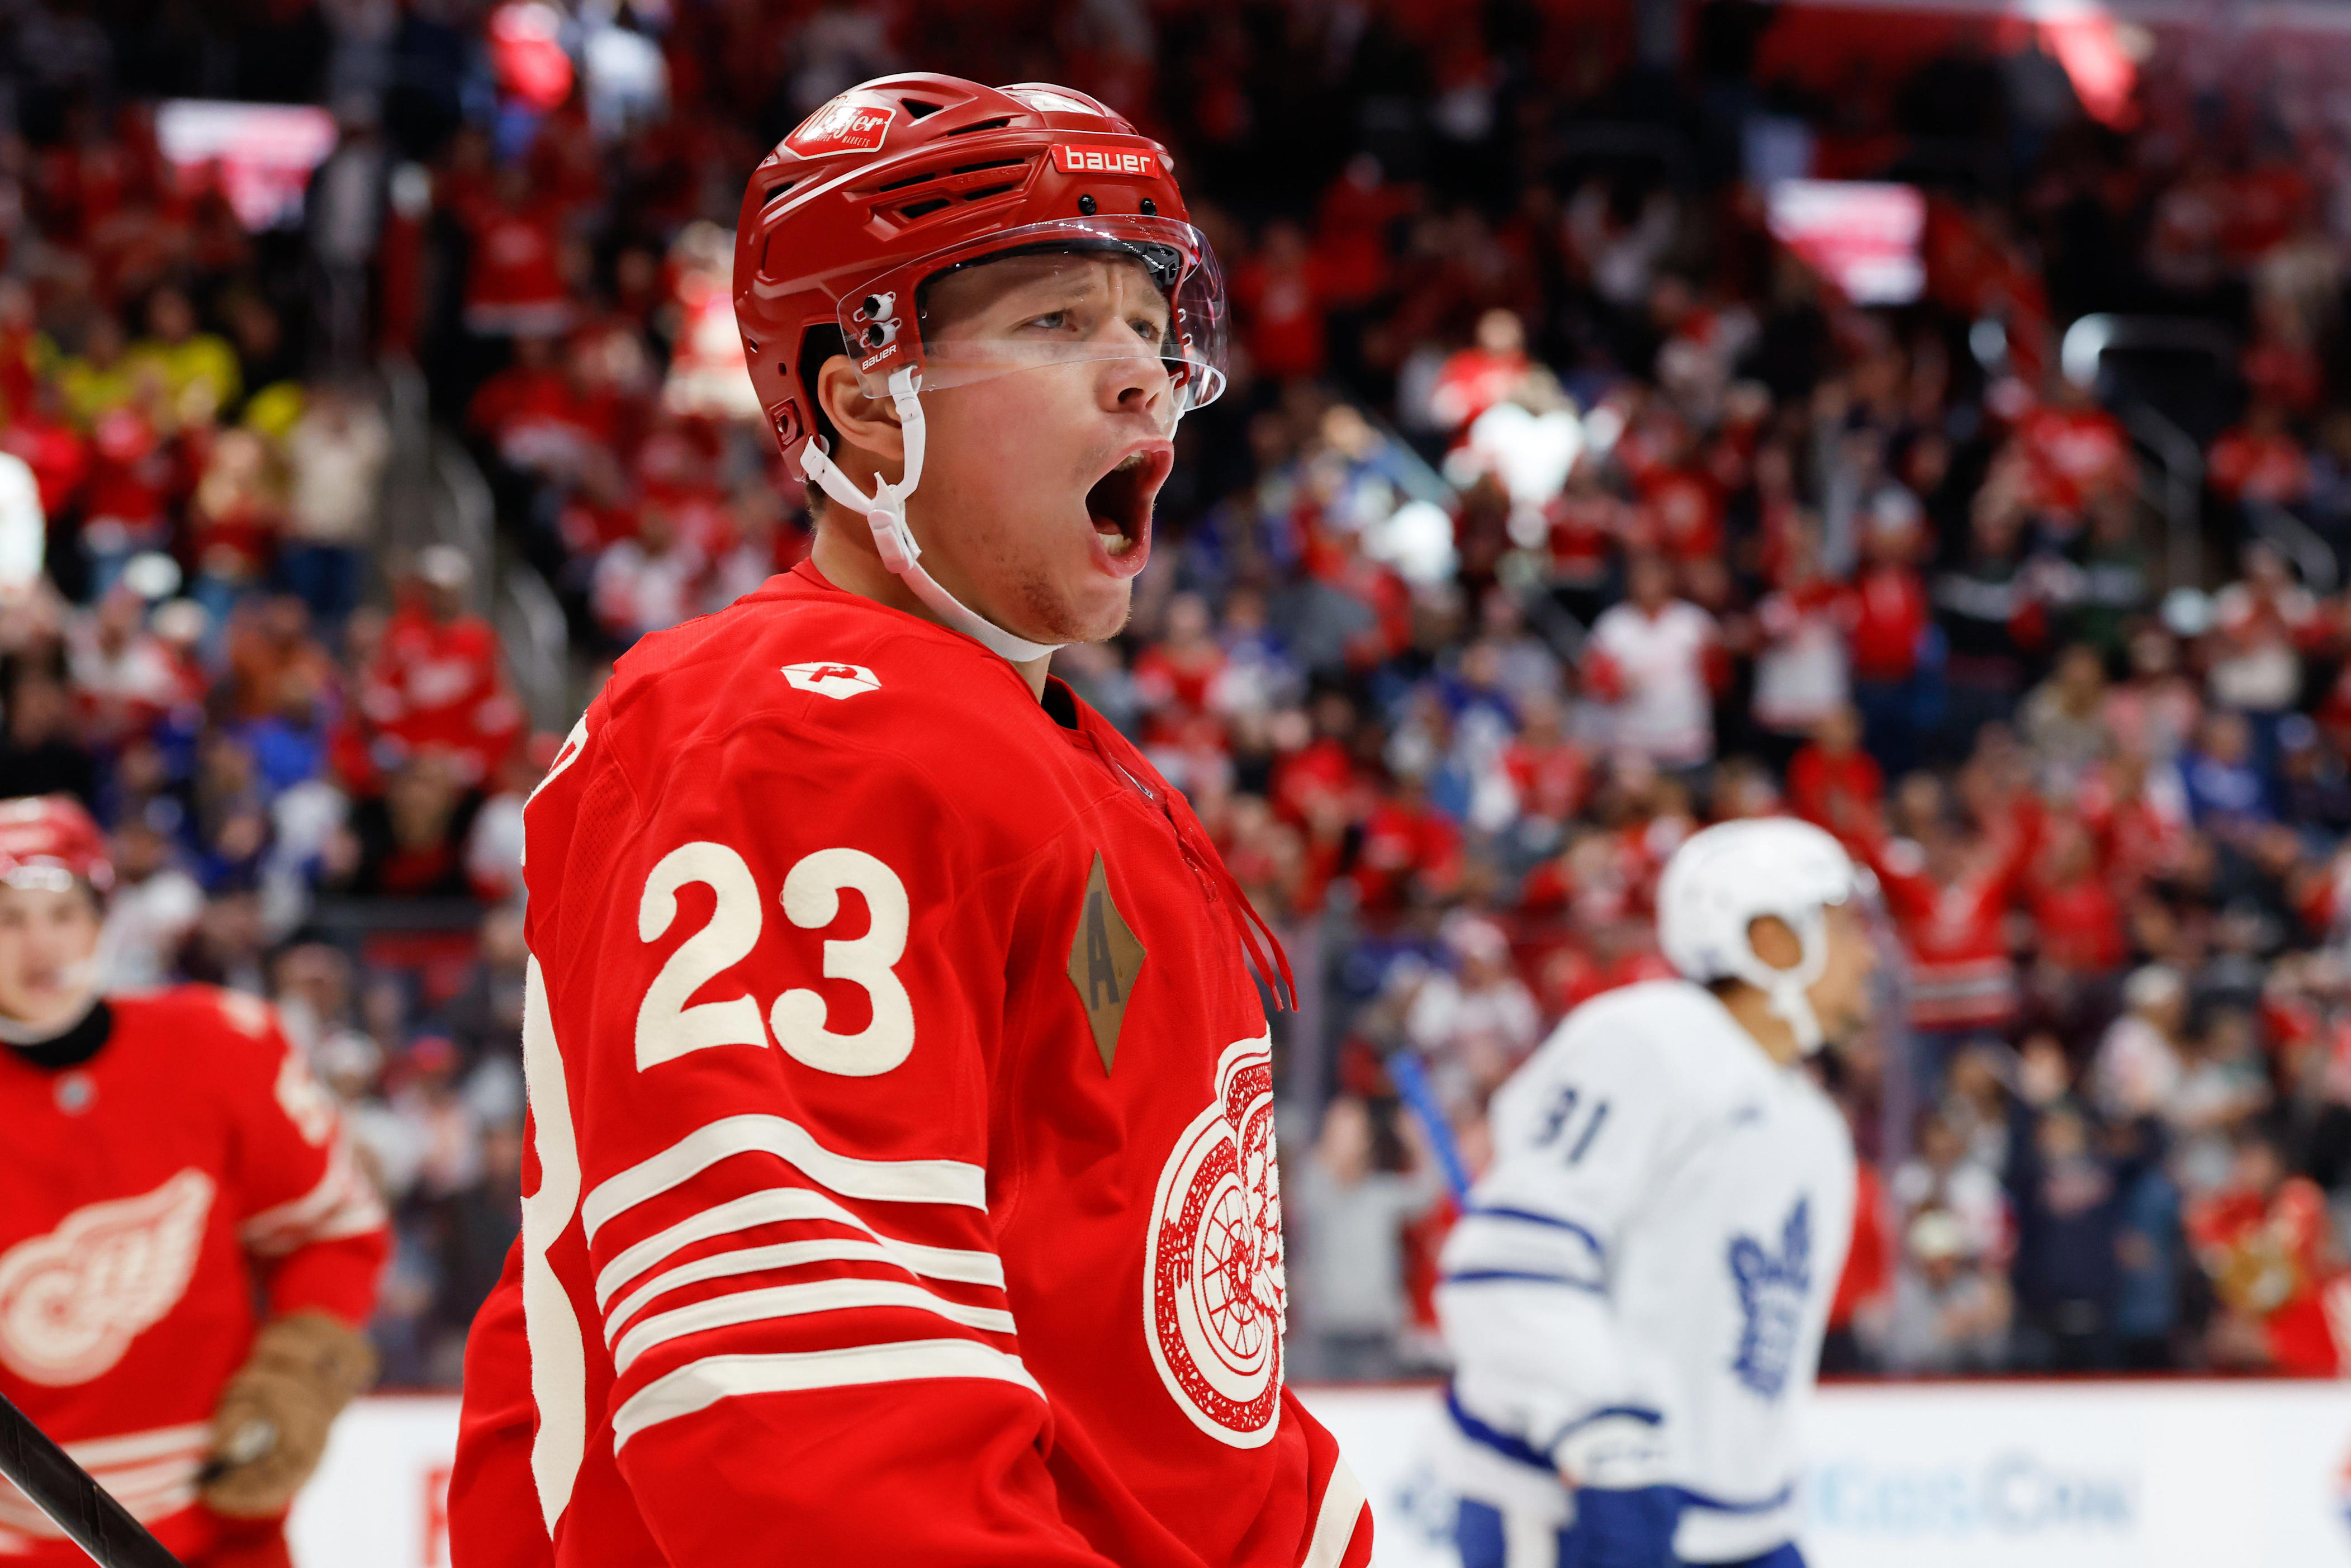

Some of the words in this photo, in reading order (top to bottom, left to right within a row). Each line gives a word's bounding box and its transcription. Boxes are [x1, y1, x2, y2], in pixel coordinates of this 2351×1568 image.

[841, 135, 871, 148] MARKETS
[1065, 145, 1150, 172] bauer
[634, 841, 916, 1077] 23
[1087, 891, 1120, 1011] A
